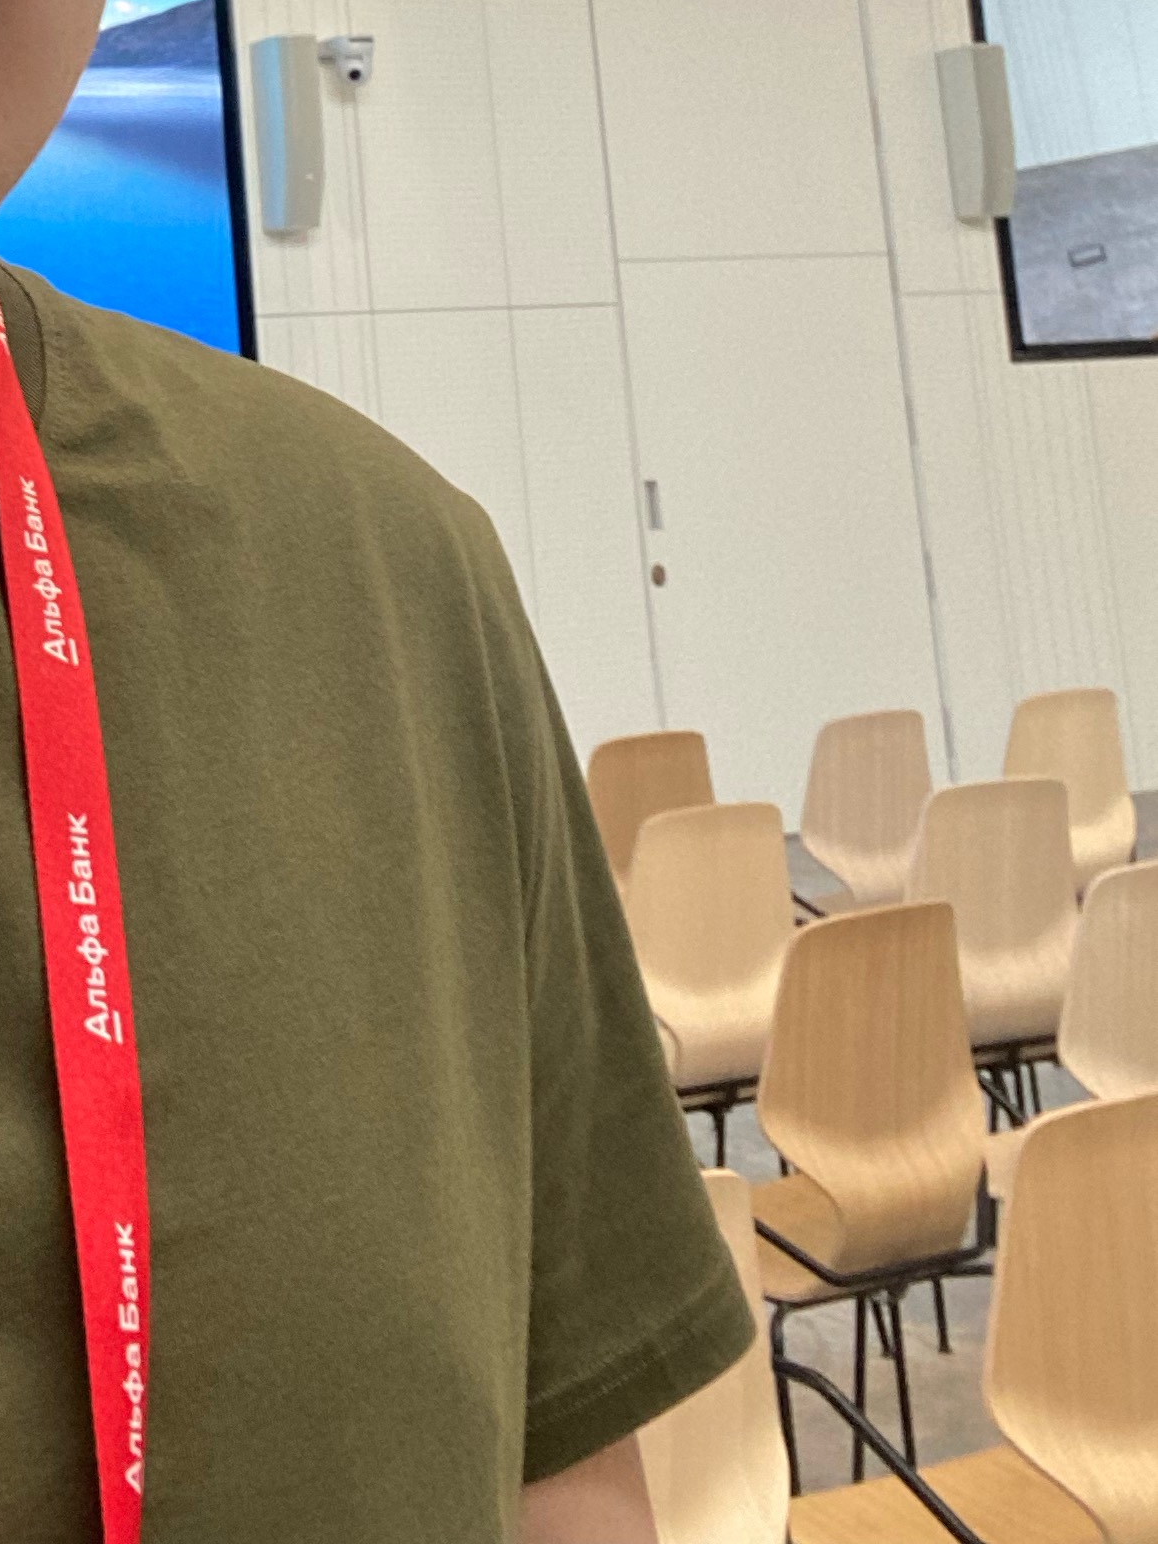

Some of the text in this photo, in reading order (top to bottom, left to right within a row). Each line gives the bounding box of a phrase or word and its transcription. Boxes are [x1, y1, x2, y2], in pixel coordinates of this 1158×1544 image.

[19, 475, 79, 667] Альфа Банк
[67, 811, 123, 1044] Альфа Банк
[114, 1221, 144, 1496] Альфа Банк
